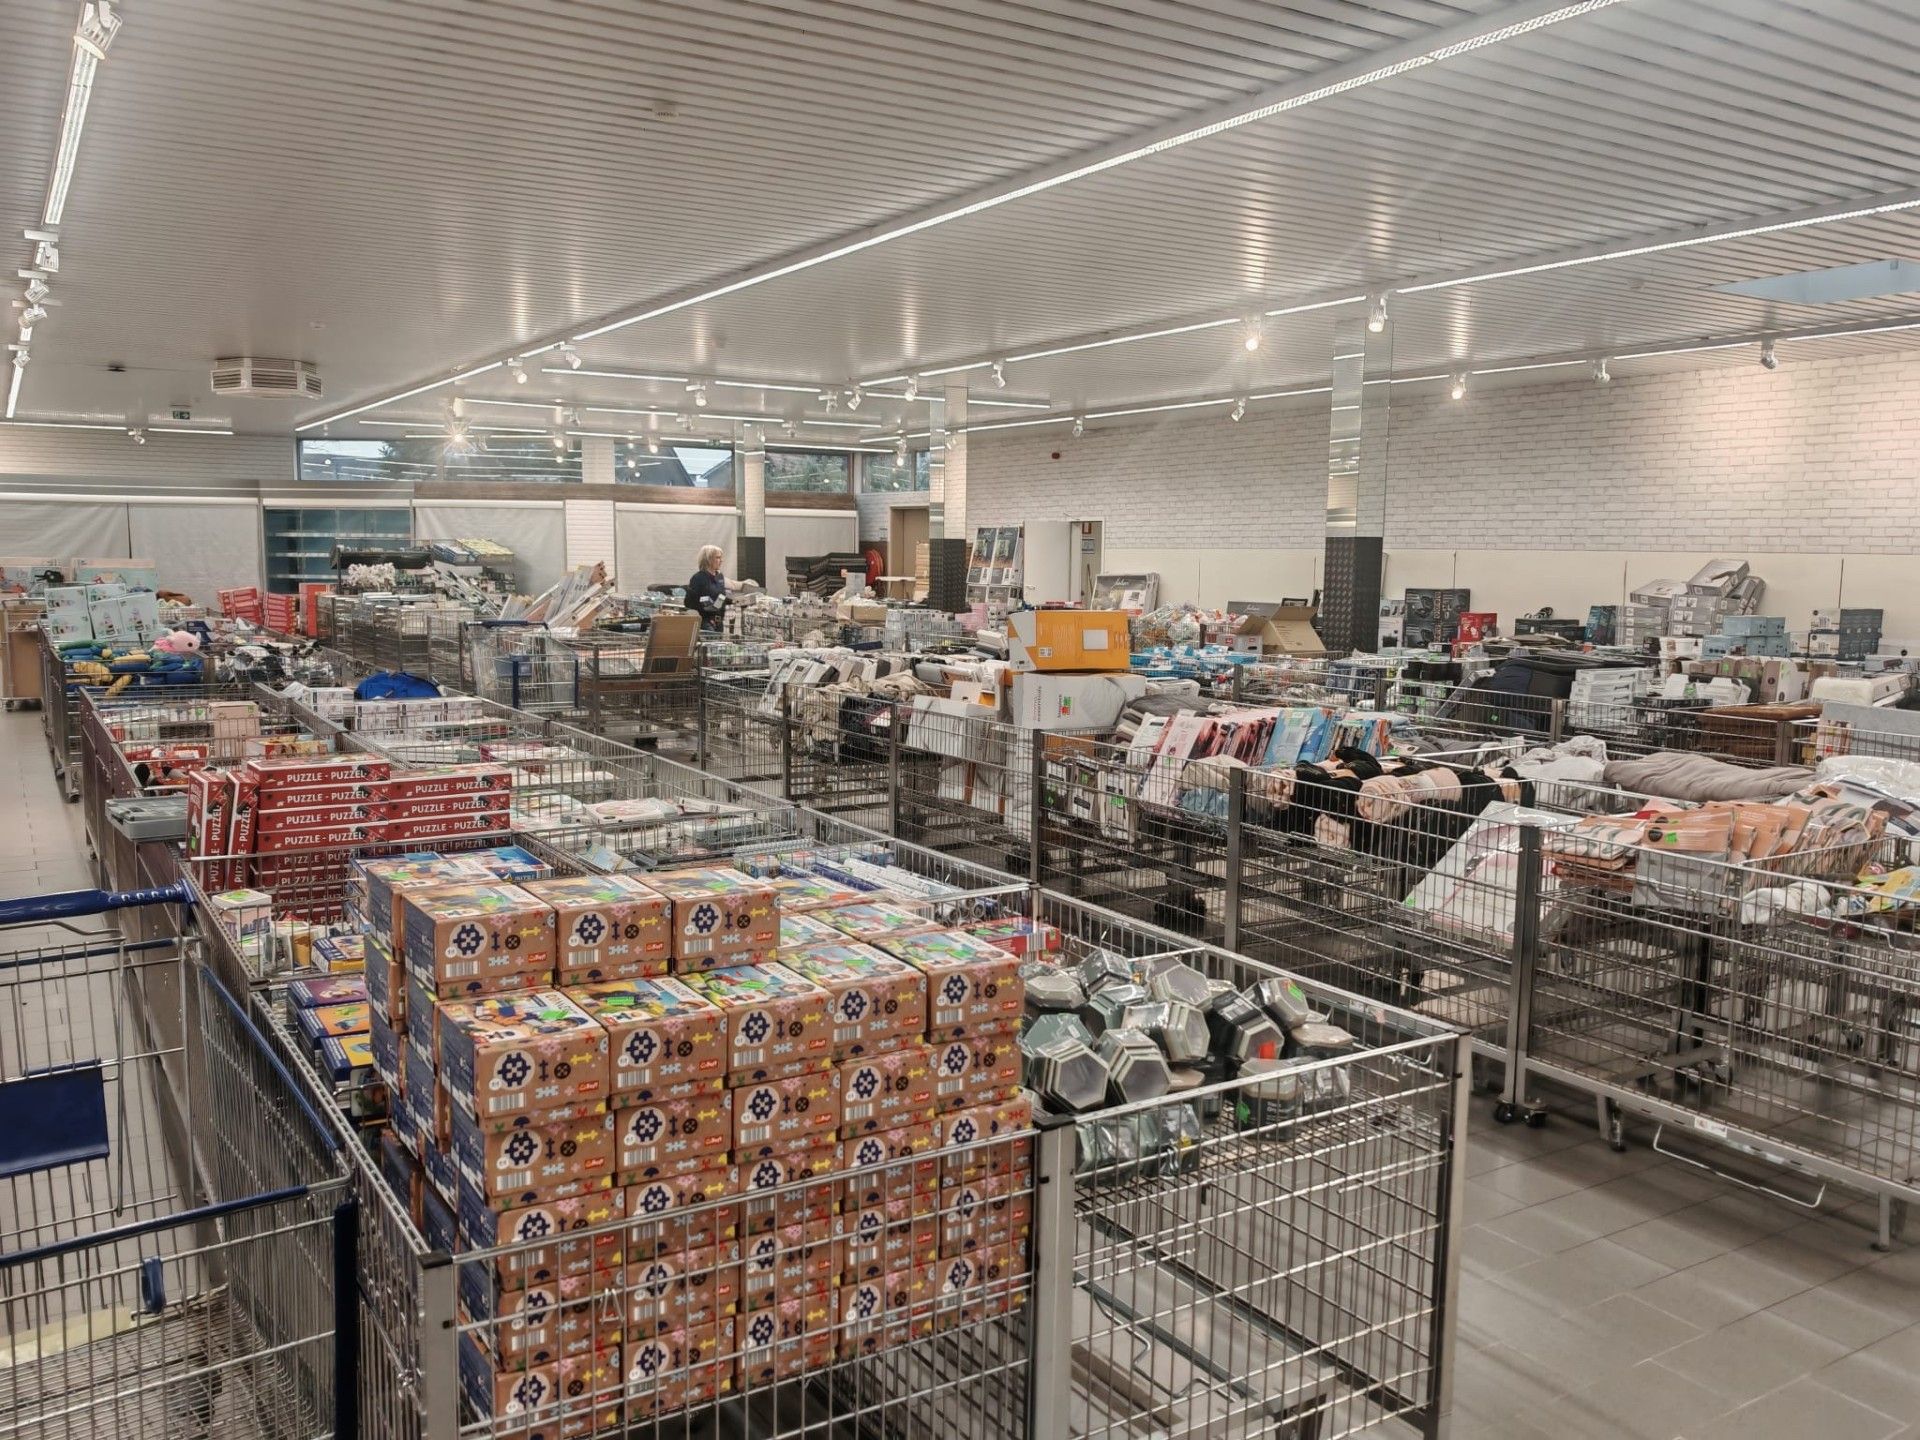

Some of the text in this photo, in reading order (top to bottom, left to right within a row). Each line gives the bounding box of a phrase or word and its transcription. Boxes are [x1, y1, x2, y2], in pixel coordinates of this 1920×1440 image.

[287, 772, 322, 783] PUZZLE
[331, 770, 365, 780] PUZZEL
[416, 784, 449, 794] PUZZLE
[456, 781, 488, 790] PUZZEL
[287, 794, 323, 803] PUZZLE
[331, 790, 366, 800] PUZZEL
[411, 804, 445, 814] PUZZLE
[453, 801, 485, 810] PUZZEL
[212, 806, 222, 841] PUZZEL
[286, 814, 322, 824] PUZZLE
[330, 811, 364, 821] PUZZEL
[239, 808, 251, 842] PUZZEL
[413, 824, 447, 834] PUZZLE
[454, 821, 487, 830] PUZZEL
[284, 834, 320, 845] PUZZLE
[329, 831, 363, 842] PUZZEL
